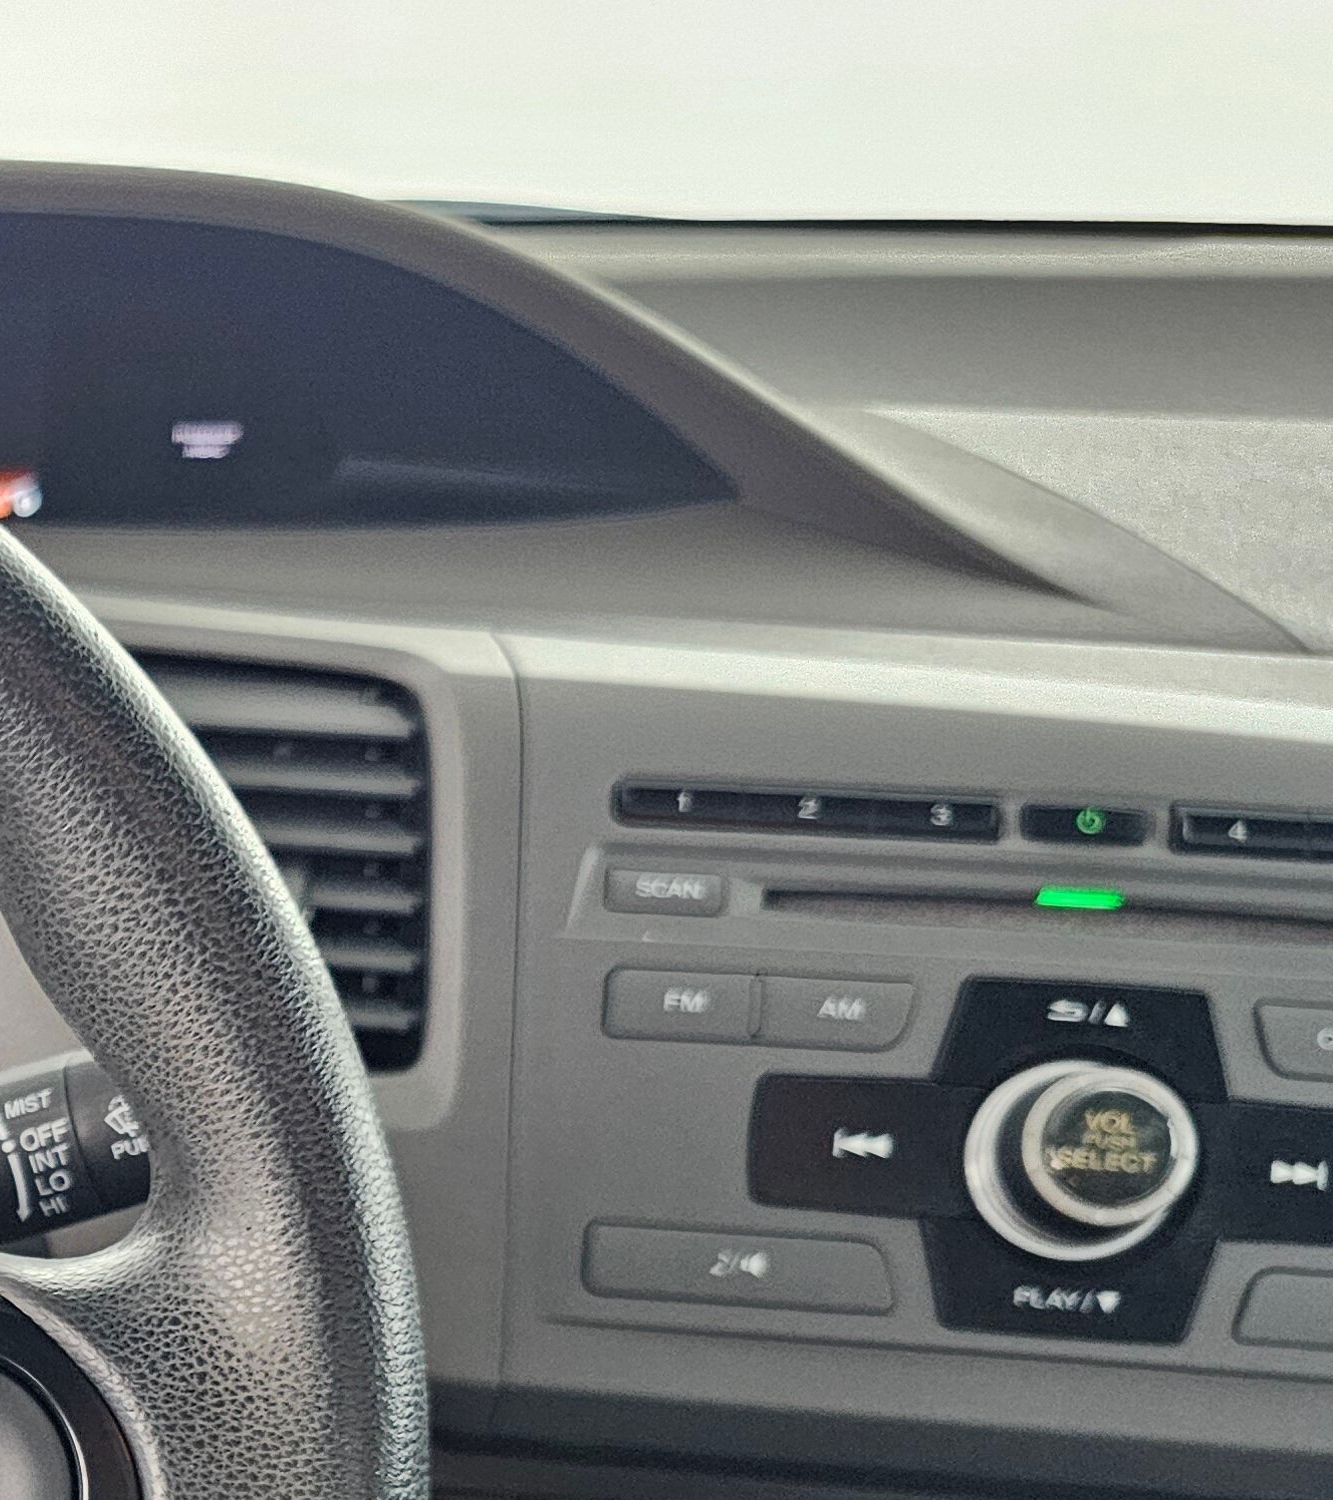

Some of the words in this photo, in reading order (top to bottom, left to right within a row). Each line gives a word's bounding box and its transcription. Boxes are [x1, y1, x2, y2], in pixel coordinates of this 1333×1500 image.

[797, 795, 821, 820] 2
[931, 803, 955, 826] 3
[1228, 820, 1248, 842] 4
[635, 876, 707, 900] SCAN
[664, 987, 709, 1012] FM
[817, 996, 866, 1020] AM
[4, 1088, 53, 1120] MIST
[19, 1117, 70, 1152] OFF
[1085, 1109, 1138, 1137] VOL
[28, 1142, 70, 1174] INT
[35, 1168, 73, 1196] LO
[38, 1193, 70, 1217] HI
